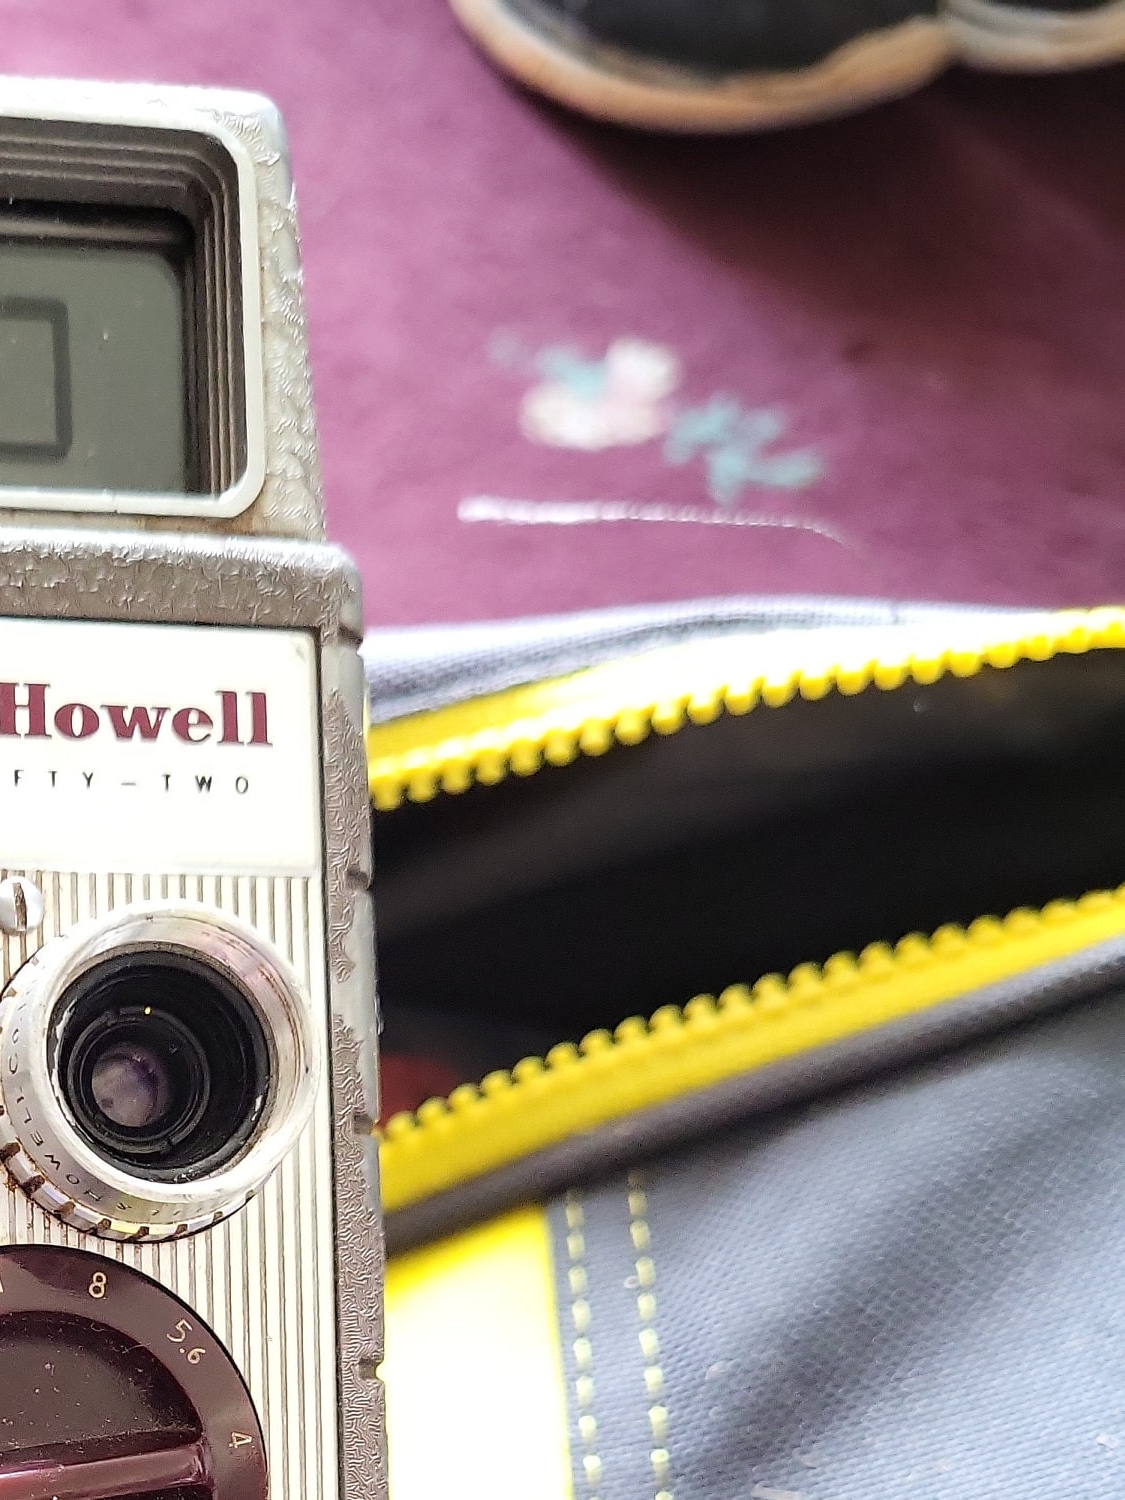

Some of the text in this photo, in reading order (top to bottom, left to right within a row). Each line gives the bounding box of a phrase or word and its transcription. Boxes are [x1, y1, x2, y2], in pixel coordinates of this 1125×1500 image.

[88, 1272, 107, 1299] 8
[166, 1318, 206, 1365] 5.6
[228, 1430, 253, 1449] 4
